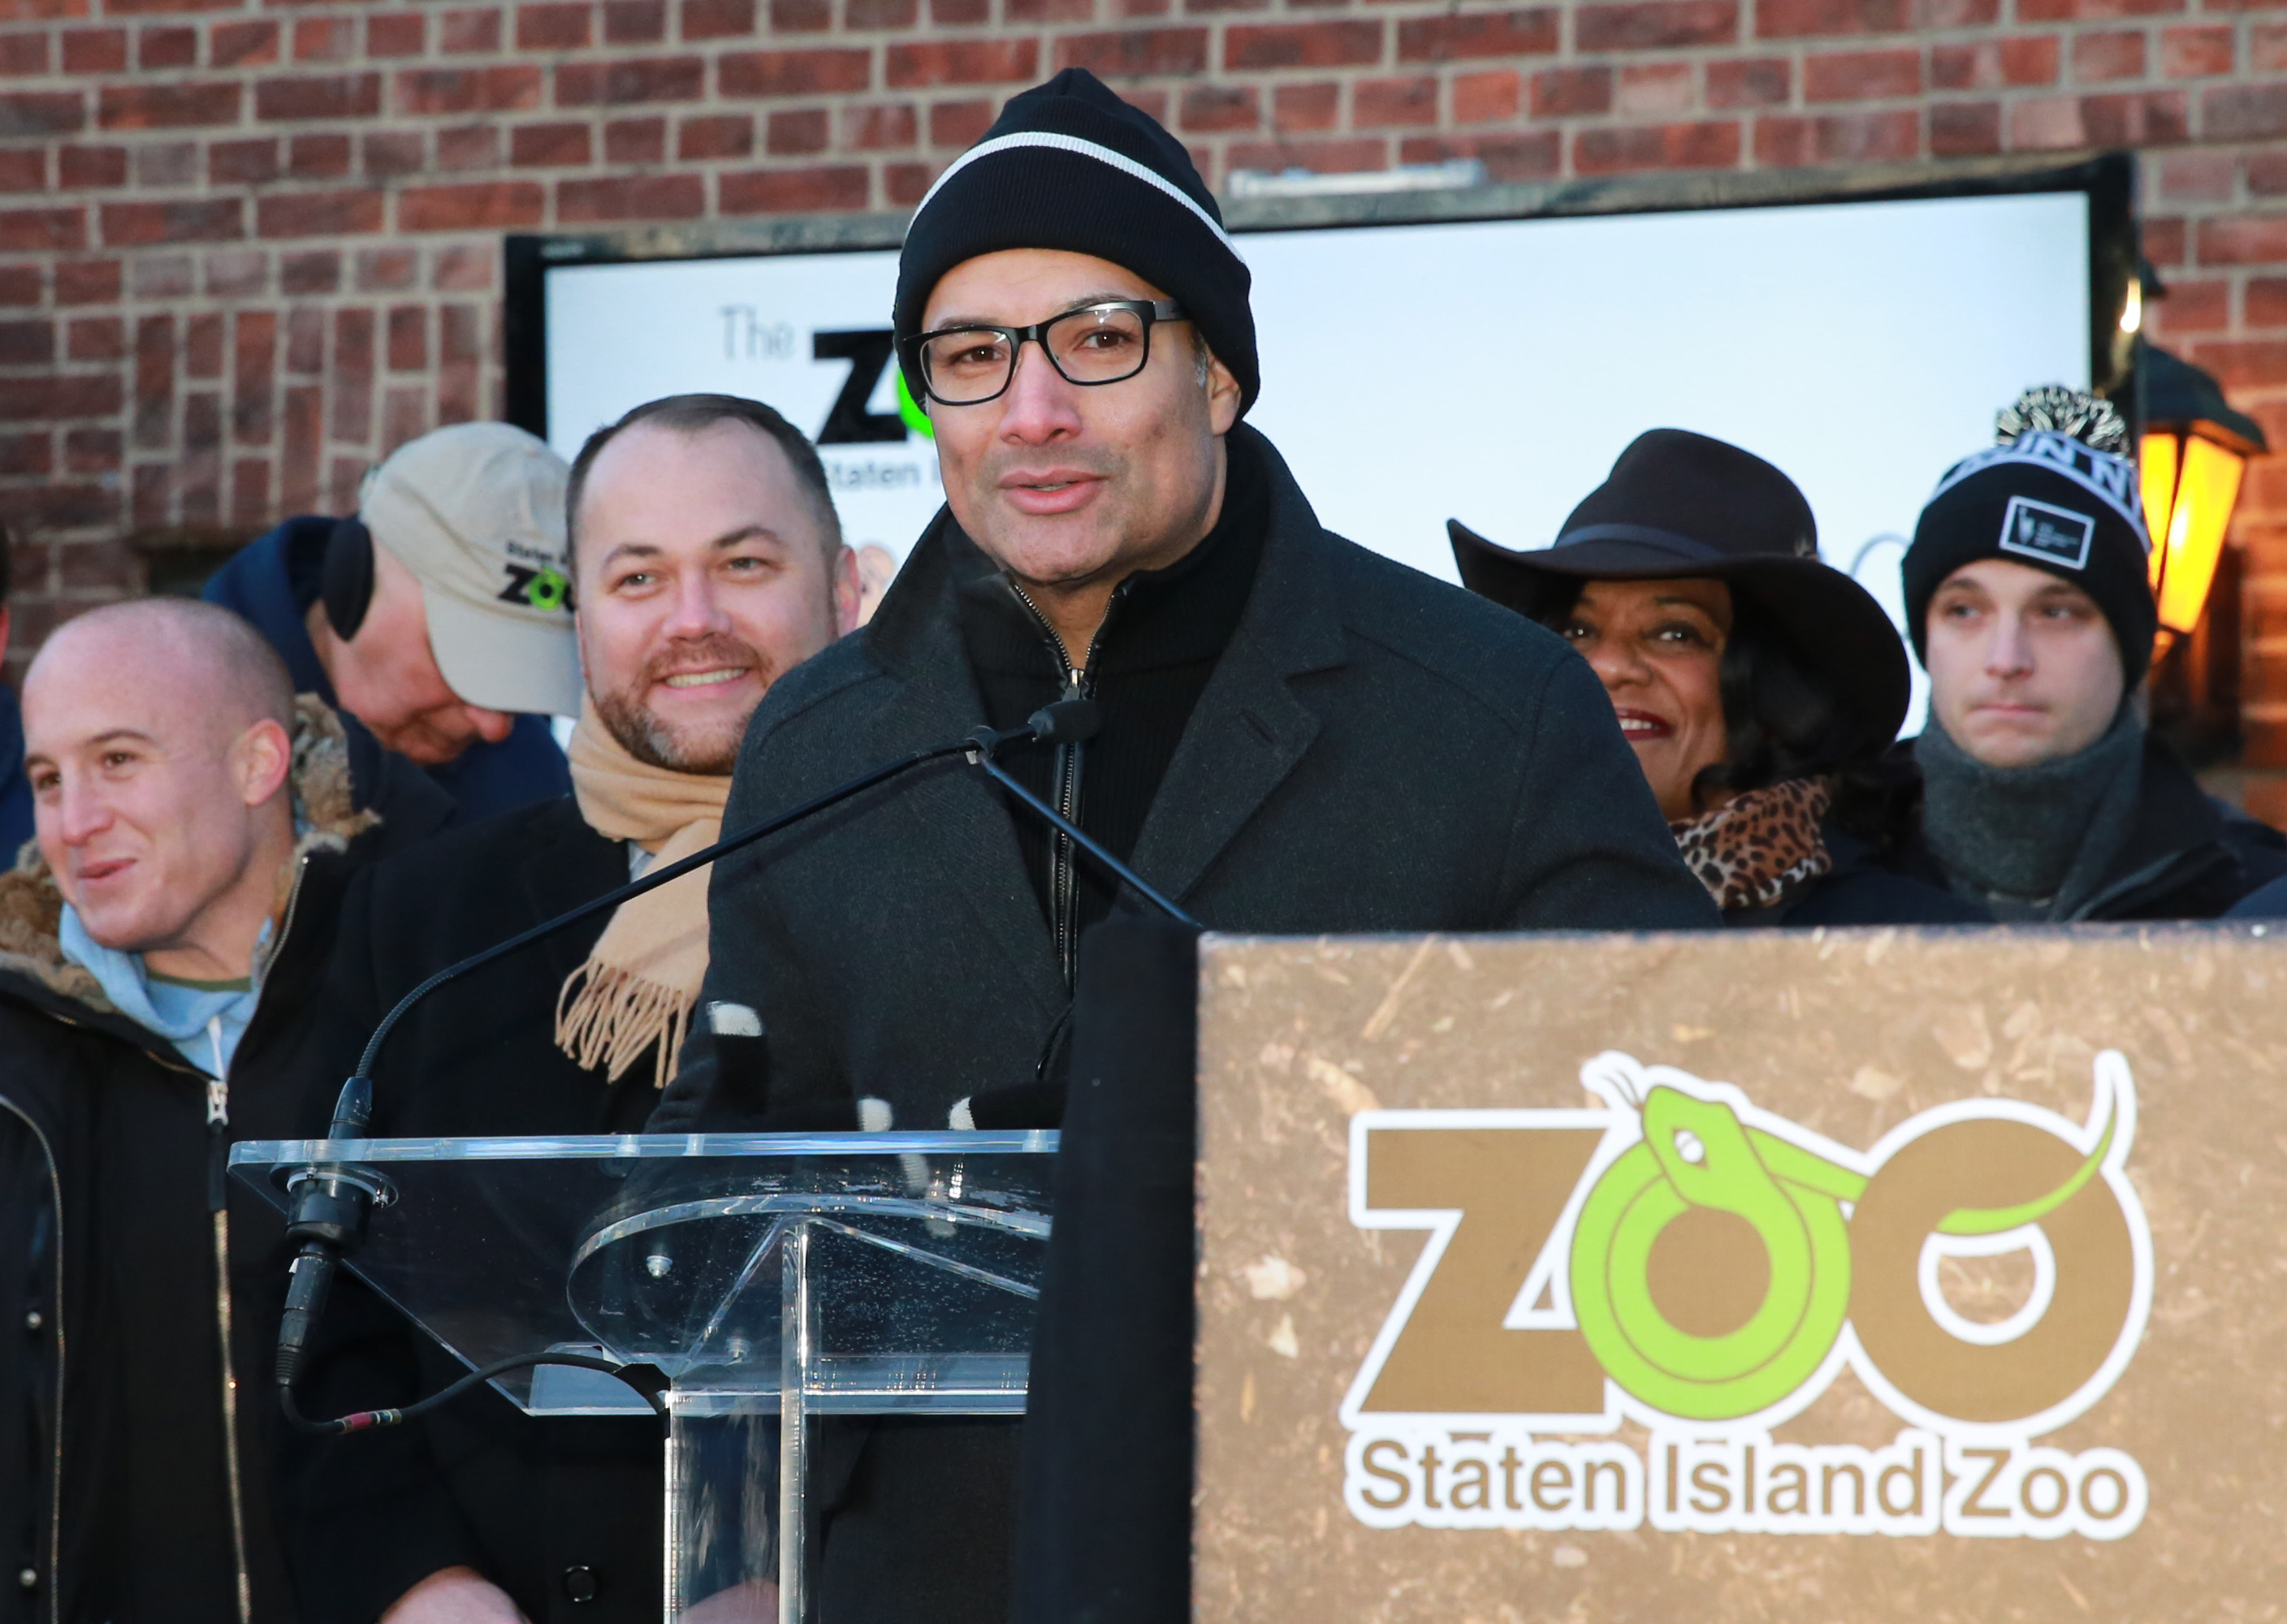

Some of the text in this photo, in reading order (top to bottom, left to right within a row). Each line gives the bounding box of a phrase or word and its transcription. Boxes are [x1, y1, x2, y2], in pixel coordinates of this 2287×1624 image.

[720, 303, 935, 446] The Z
[828, 460, 921, 488] taten
[1358, 1080, 2136, 1423] ZOO
[1360, 1440, 2129, 1521] Staten Island Zoo
